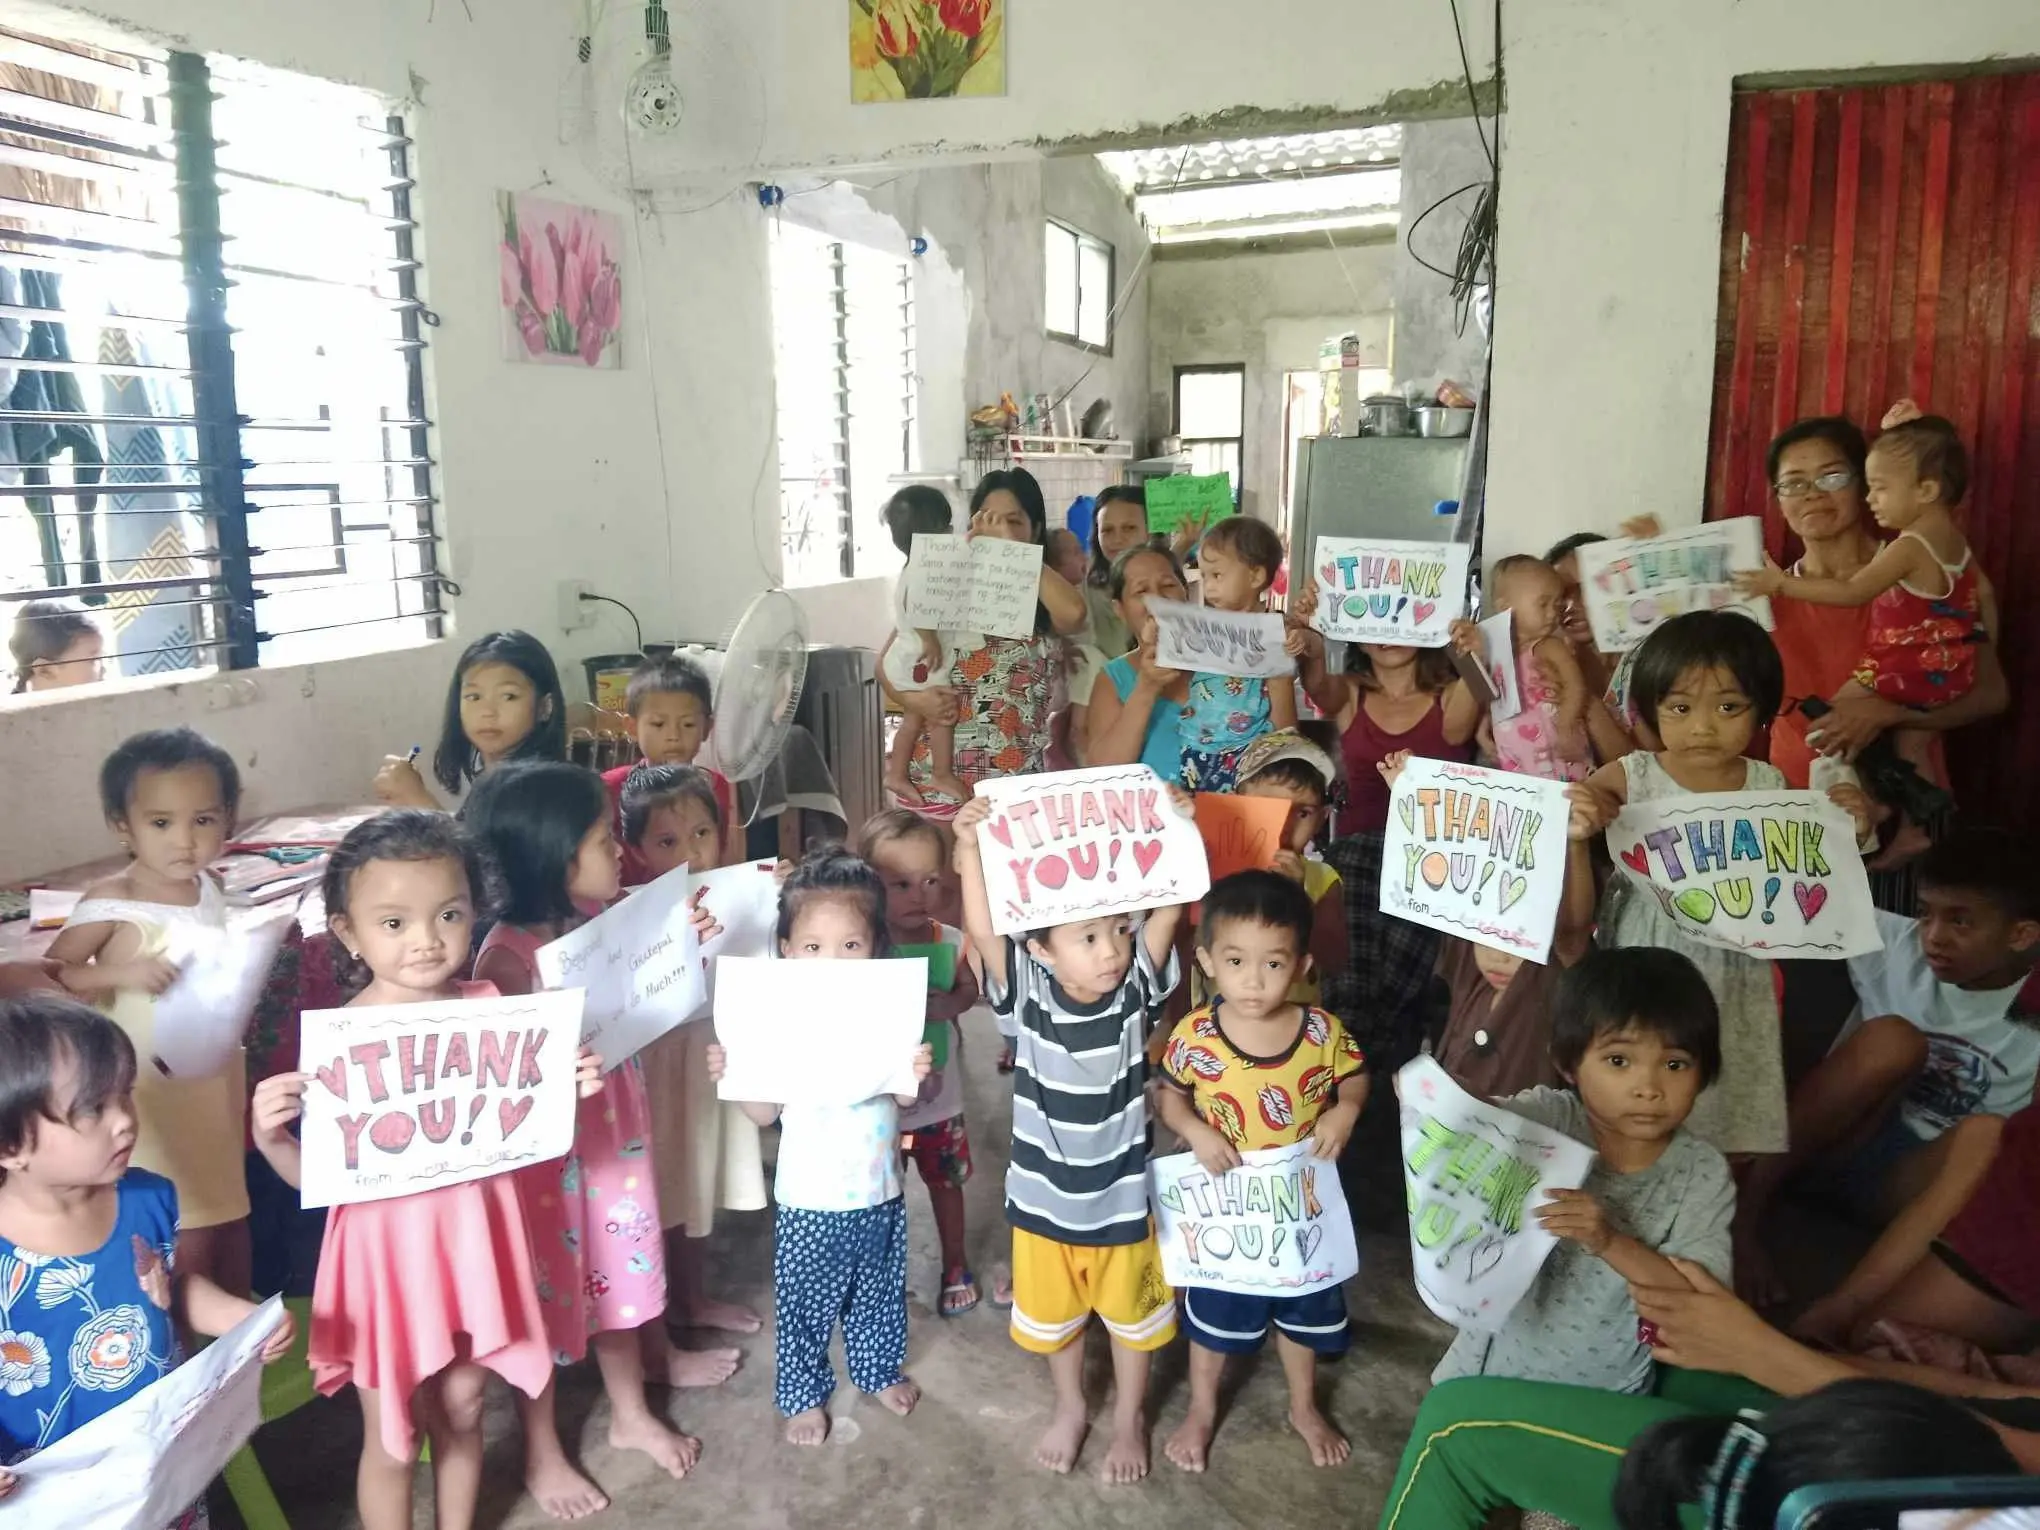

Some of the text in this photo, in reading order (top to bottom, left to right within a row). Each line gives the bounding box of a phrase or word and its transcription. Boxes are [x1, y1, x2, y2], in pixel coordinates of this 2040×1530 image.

[920, 537, 960, 553] Thank
[970, 542, 992, 558] you
[1336, 555, 1447, 599] THANK
[912, 602, 946, 620] Merry
[1326, 592, 1409, 625] YOU!
[1007, 786, 1165, 850] THANK
[1416, 788, 1544, 871] THANK
[1007, 838, 1122, 904] YOU!
[1402, 843, 1496, 906] YOU!
[1644, 817, 1832, 883] THANK
[1407, 898, 1430, 914] from
[1650, 876, 1781, 925] YOU!
[645, 964, 687, 1000] Much!!!
[348, 1026, 550, 1105] THANK
[334, 1093, 488, 1170] YOU!
[1178, 1165, 1324, 1225] THANK
[1176, 1220, 1286, 1268] YOU!
